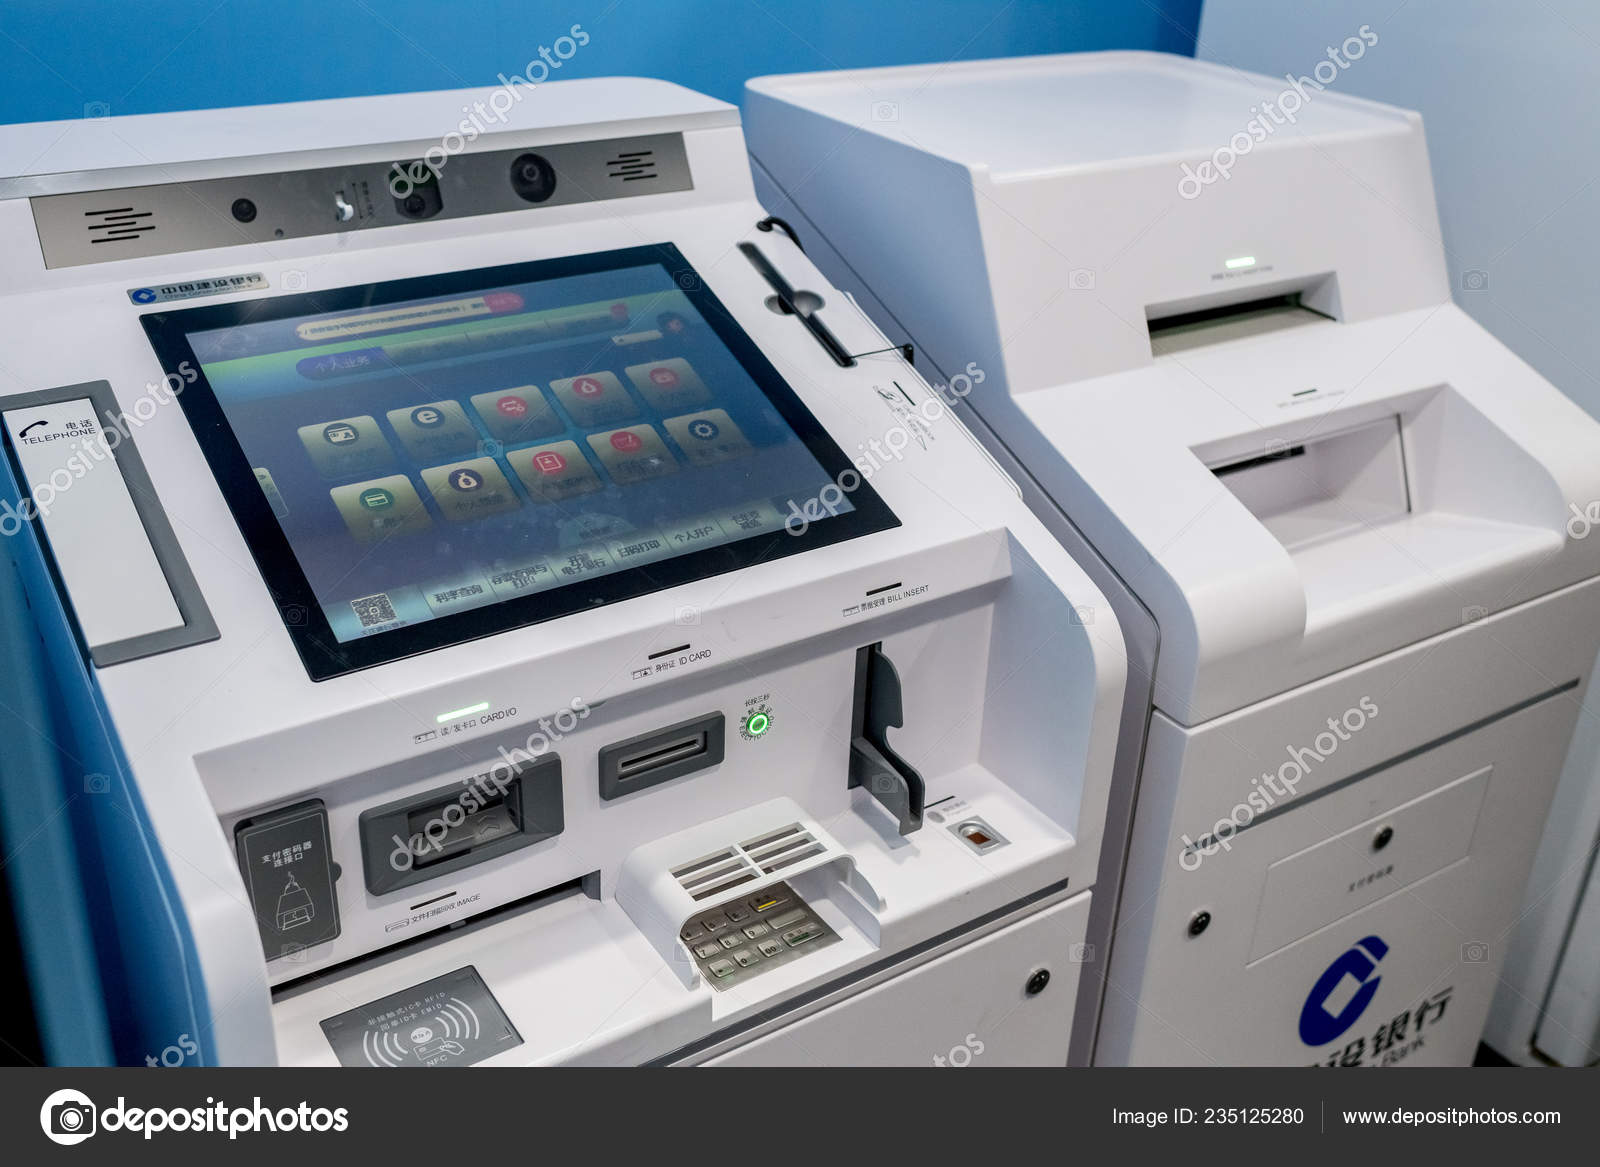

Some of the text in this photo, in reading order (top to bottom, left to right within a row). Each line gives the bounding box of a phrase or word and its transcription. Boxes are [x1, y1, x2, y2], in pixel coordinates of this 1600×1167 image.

[65, 418, 94, 430] 电话
[22, 427, 97, 446] TELEPHONE
[674, 526, 714, 542] 个人开户
[887, 594, 903, 604] BILL
[903, 584, 929, 598] INSERT
[678, 656, 688, 666] ID
[688, 649, 712, 662] CARD
[479, 710, 505, 725] CARD
[261, 840, 313, 864] 支付密码器
[274, 852, 303, 868] 连接口
[456, 894, 481, 907] IMAGE
[1310, 985, 1454, 1067] 设银行
